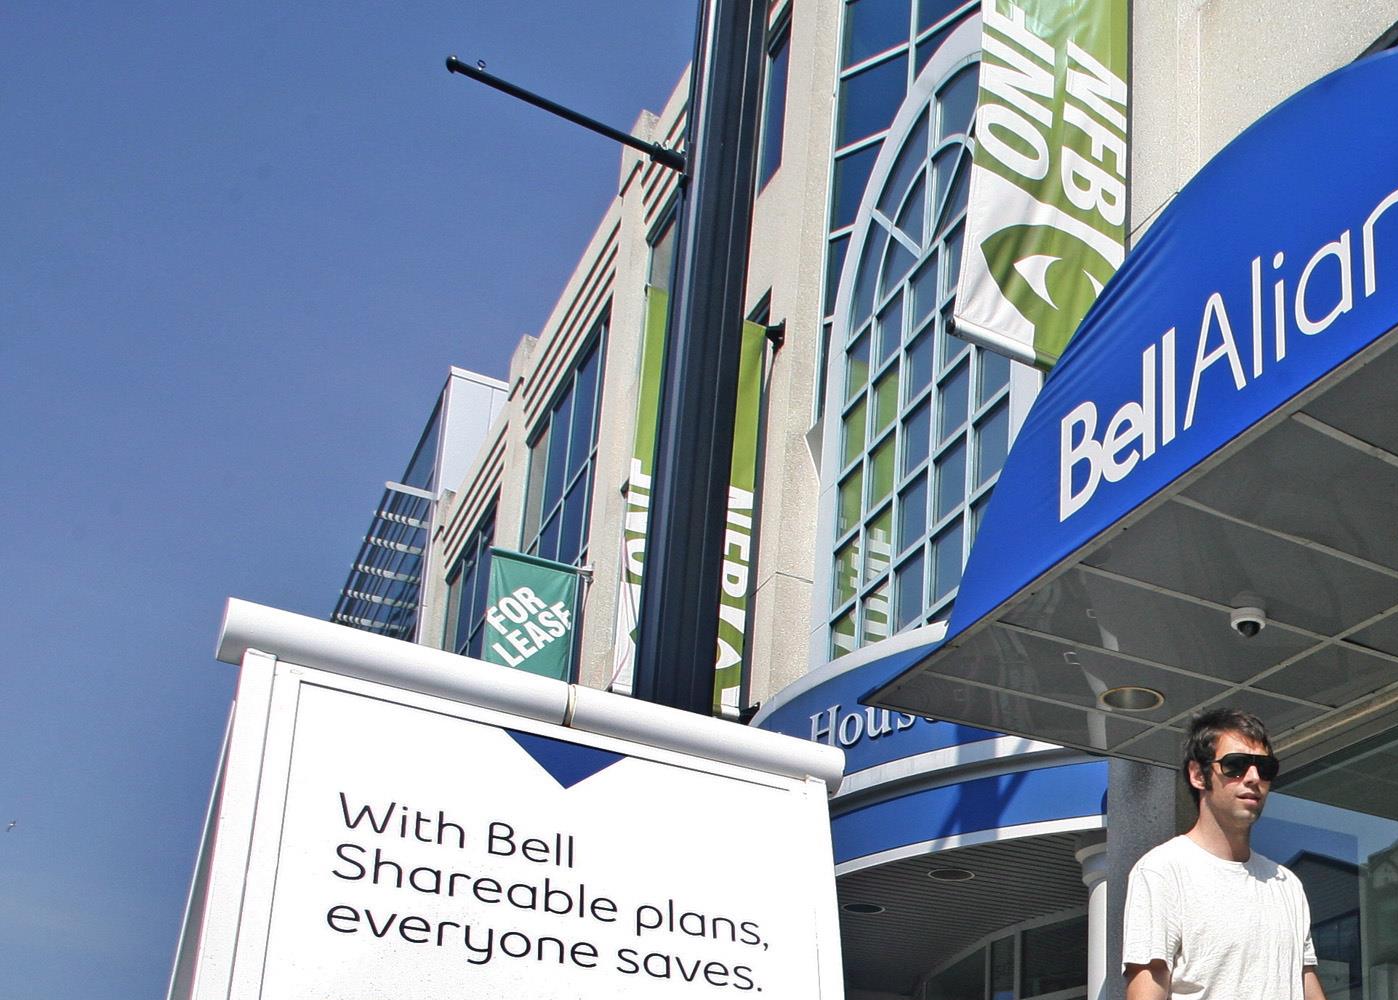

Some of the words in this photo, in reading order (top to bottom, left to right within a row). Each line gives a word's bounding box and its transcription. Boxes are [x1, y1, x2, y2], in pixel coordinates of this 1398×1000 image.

[1061, 39, 1128, 226] NFB
[486, 586, 547, 635] FOR
[492, 601, 572, 668] LEASE
[338, 791, 466, 849] With
[487, 821, 574, 869] Bell
[331, 843, 618, 922] Shareable
[636, 900, 770, 951] plans,
[326, 904, 599, 967] everyone
[616, 946, 764, 993] saves.
